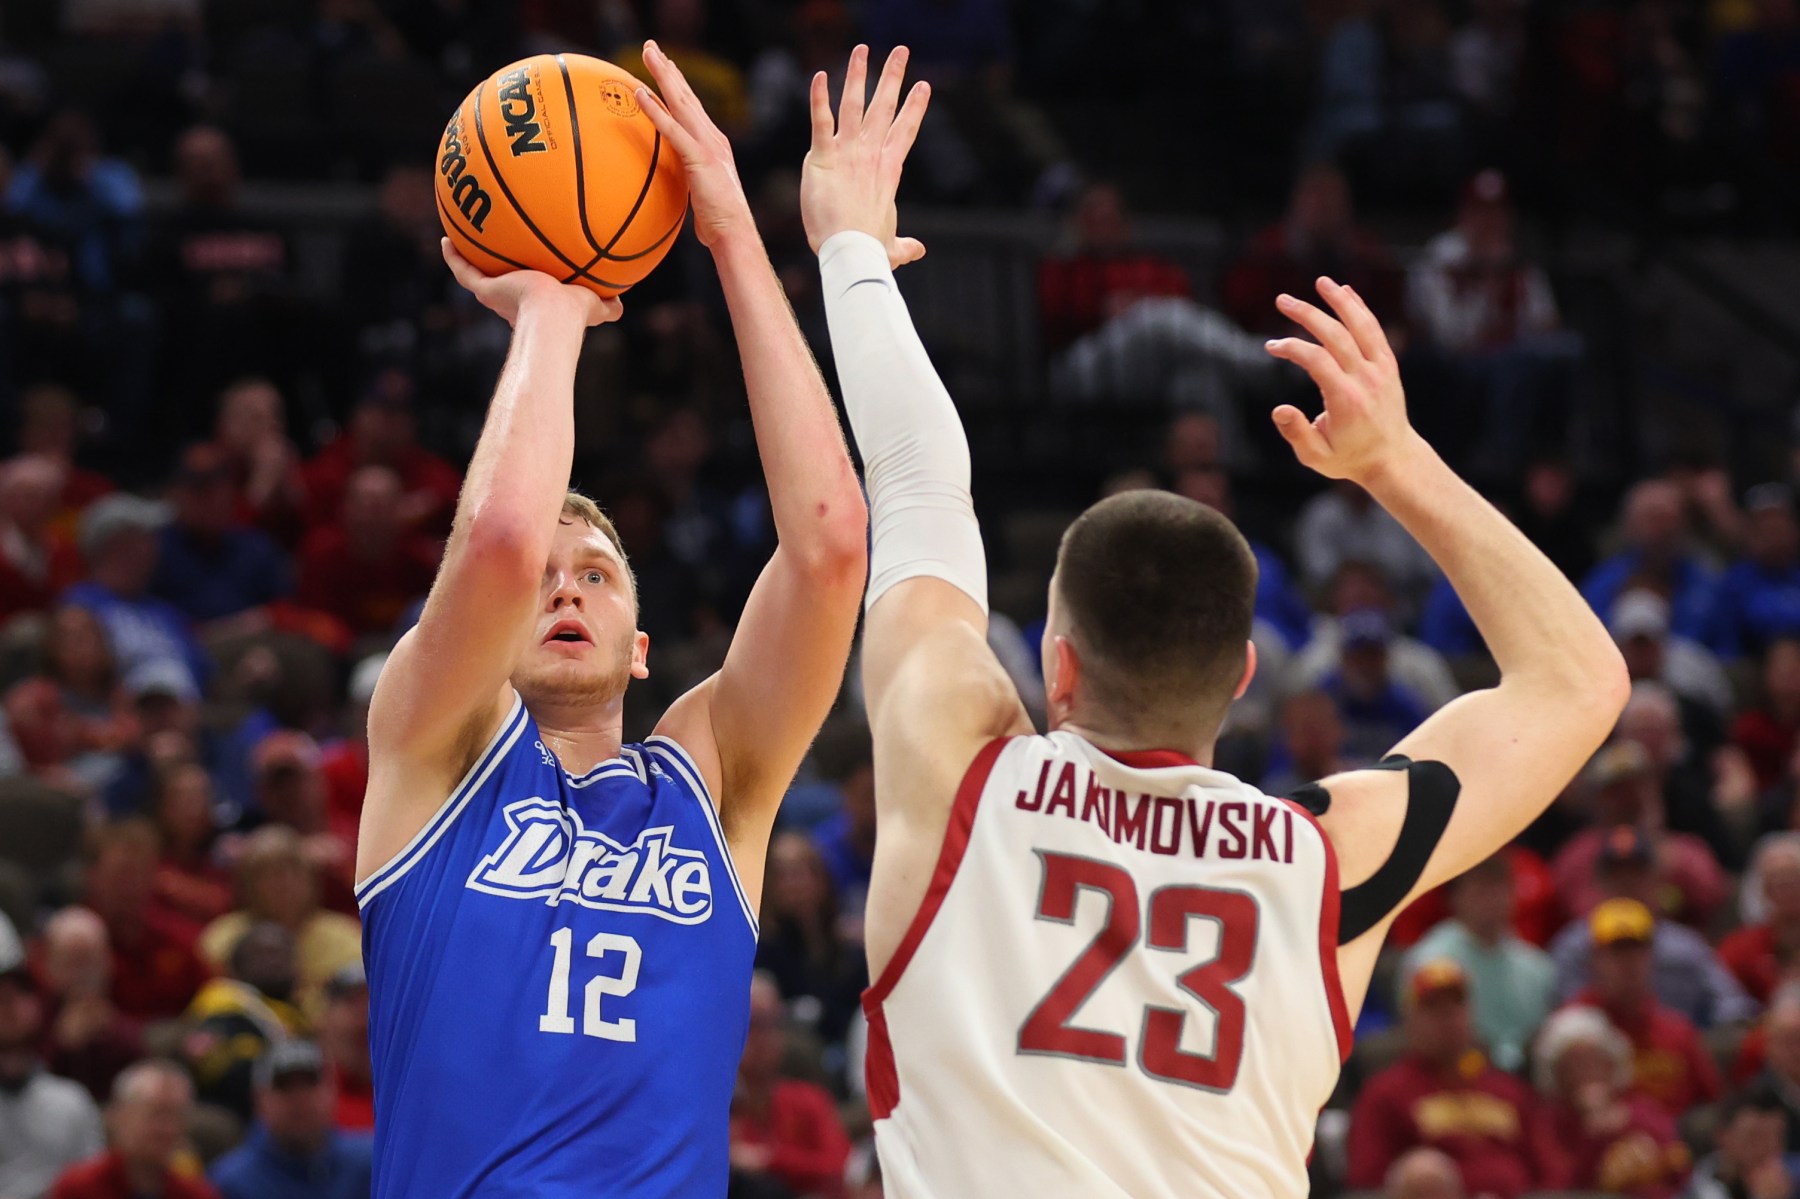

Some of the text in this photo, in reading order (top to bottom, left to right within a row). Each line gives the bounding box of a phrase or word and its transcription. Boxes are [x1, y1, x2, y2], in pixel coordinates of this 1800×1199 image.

[498, 65, 548, 157] NCAA
[541, 103, 558, 151] OFFICIAL
[465, 796, 713, 926] Drake
[1015, 759, 1294, 864] JAKIMOVSKI
[539, 927, 643, 1043] 12
[1016, 847, 1260, 1095] 23
